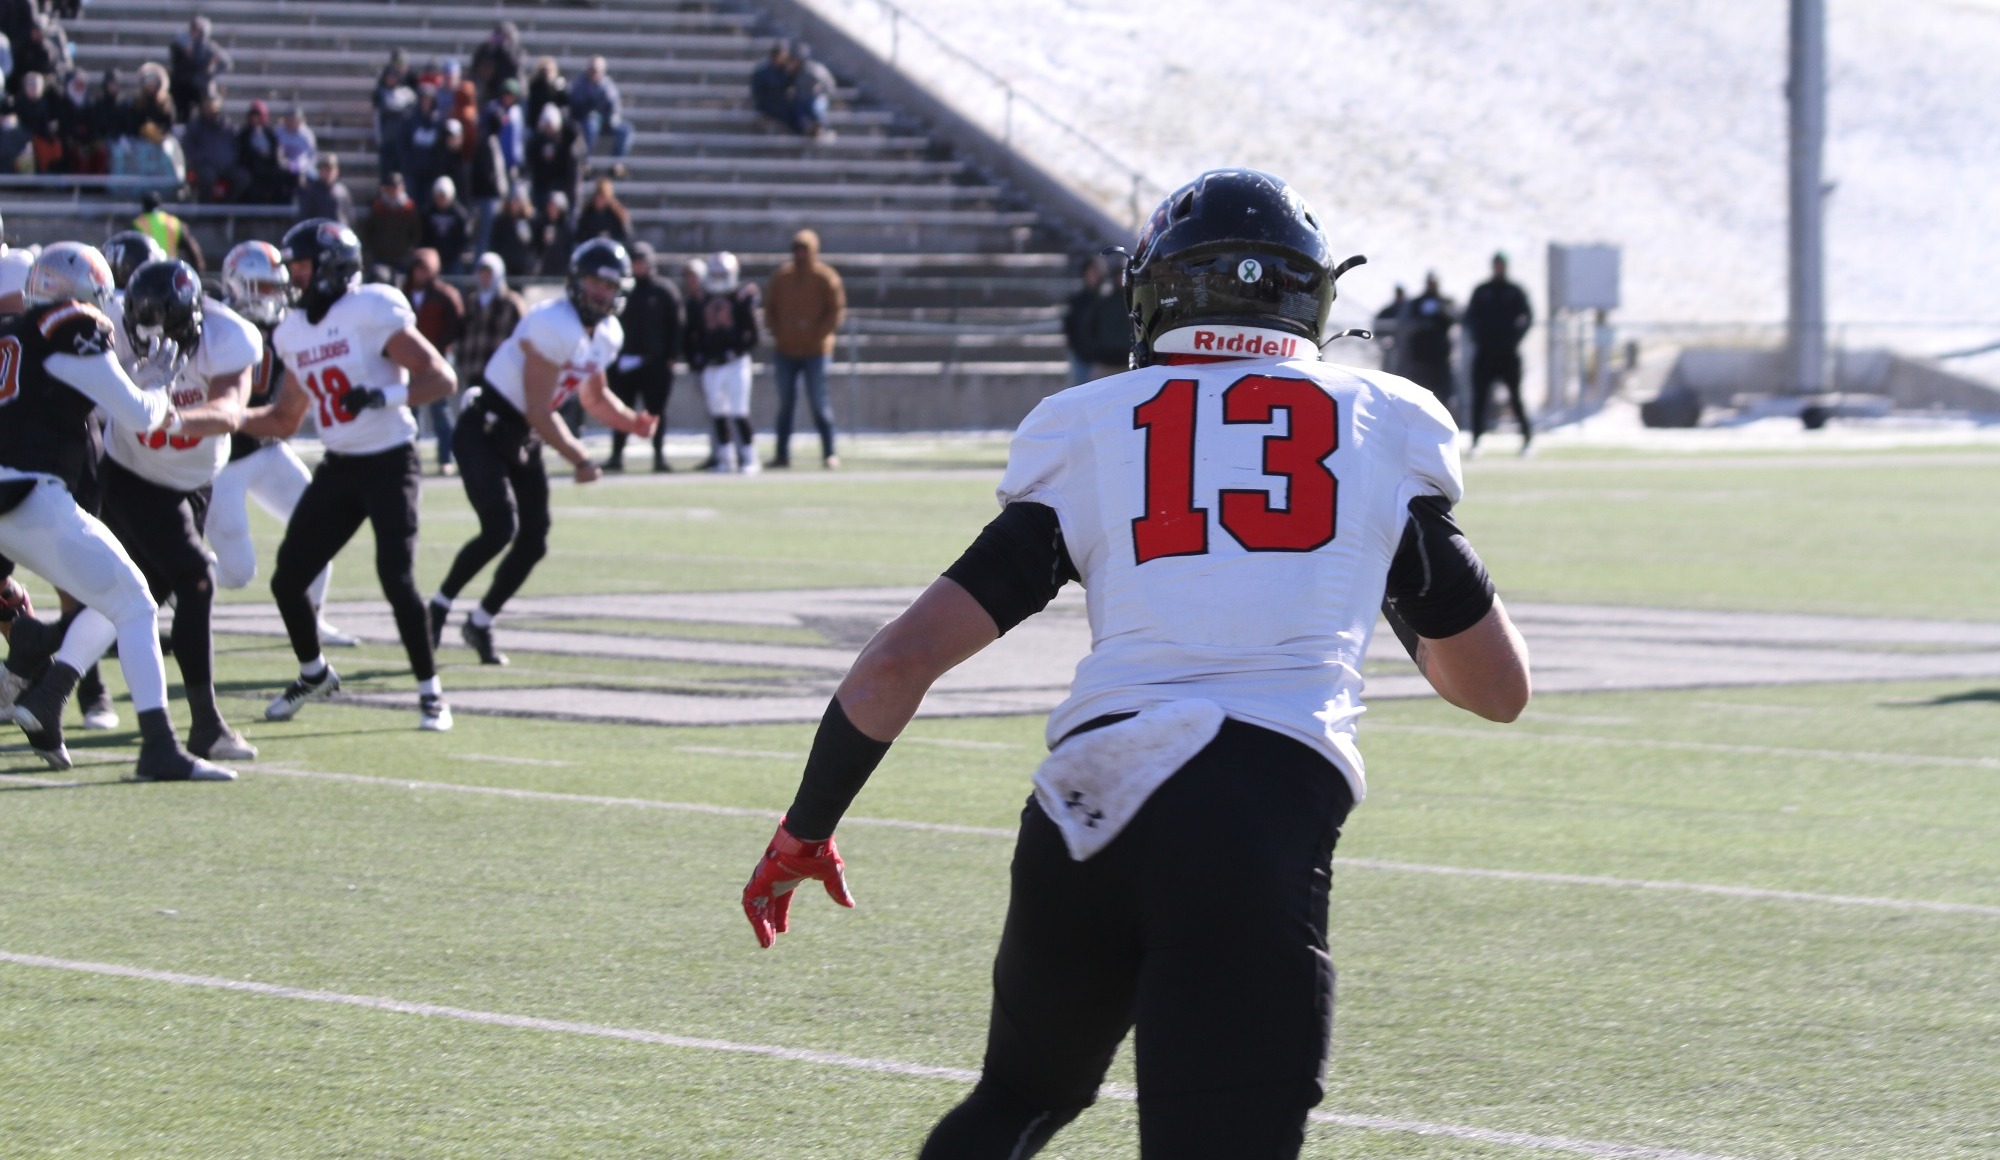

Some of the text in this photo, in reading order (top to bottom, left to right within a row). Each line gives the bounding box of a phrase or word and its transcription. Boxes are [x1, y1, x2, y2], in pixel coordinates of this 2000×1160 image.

[1194, 330, 1297, 358] Riddell
[306, 365, 356, 428] 18
[1131, 373, 1339, 566] 13
